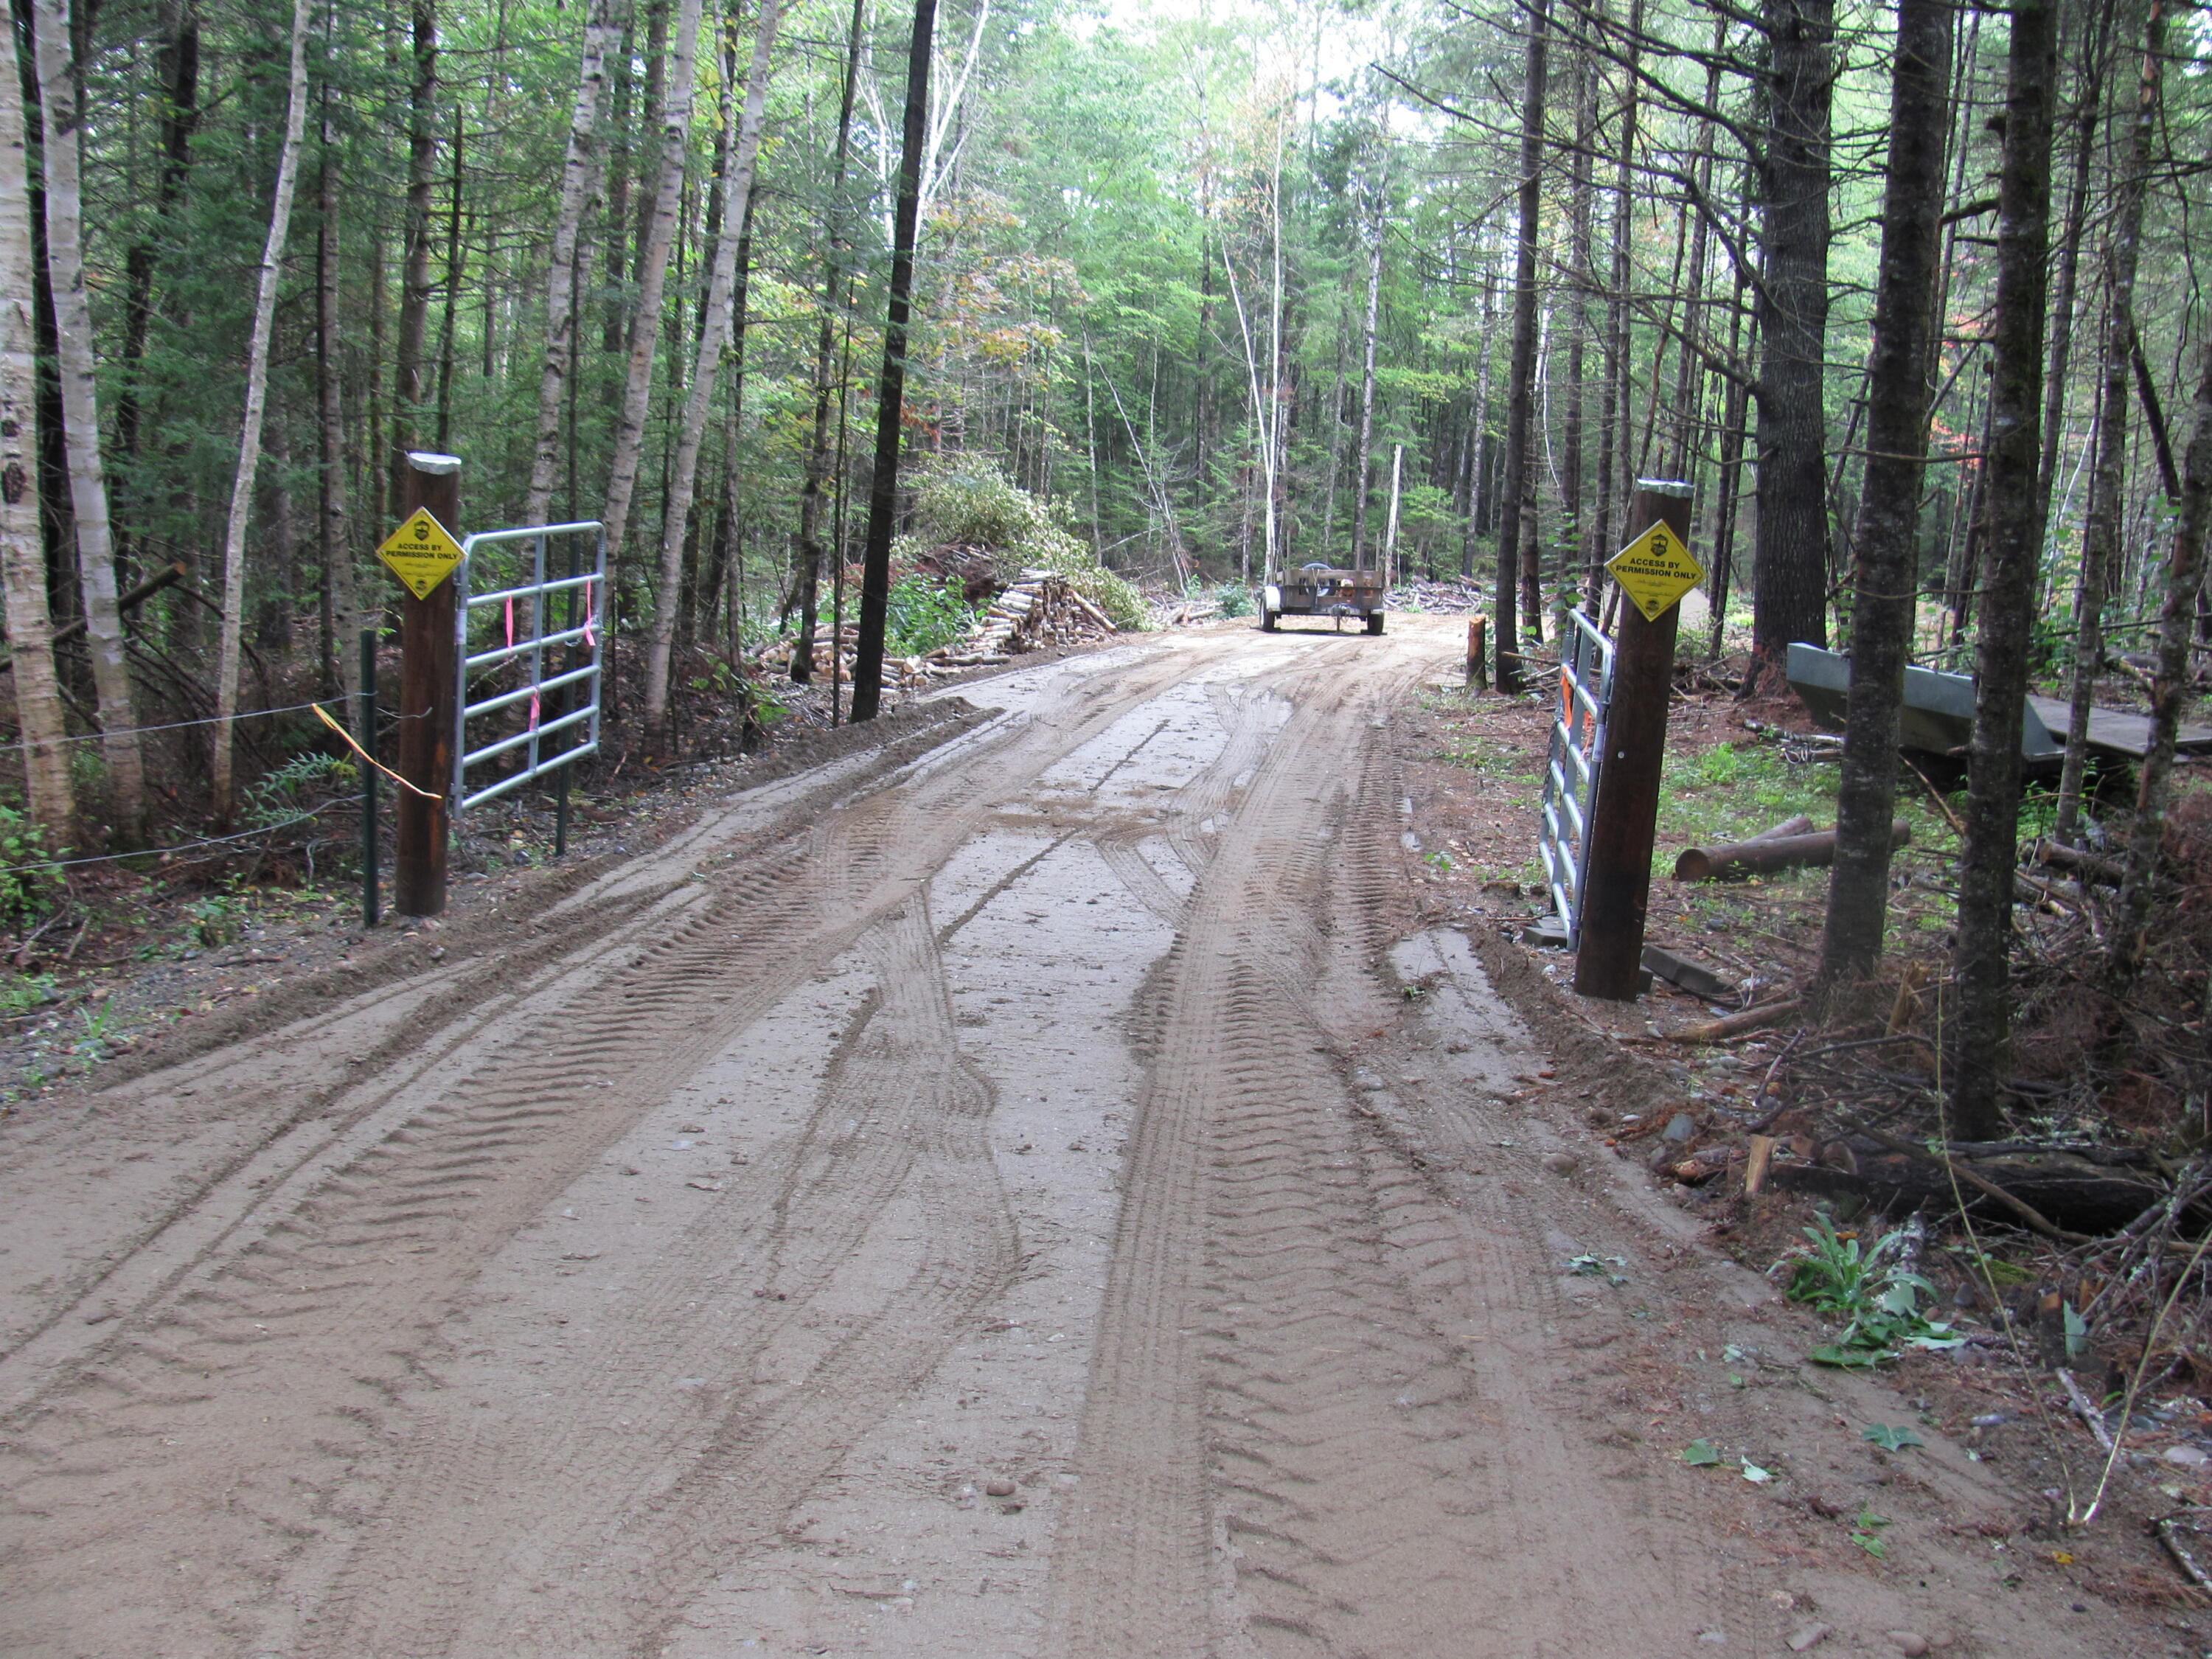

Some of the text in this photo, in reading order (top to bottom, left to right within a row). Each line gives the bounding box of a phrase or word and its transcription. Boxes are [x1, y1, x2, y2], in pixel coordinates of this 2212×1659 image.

[386, 550, 434, 558] PERMISSION
[1630, 558, 1666, 567] ACCESS
[1616, 565, 1696, 580] PERMISSION ONLY
